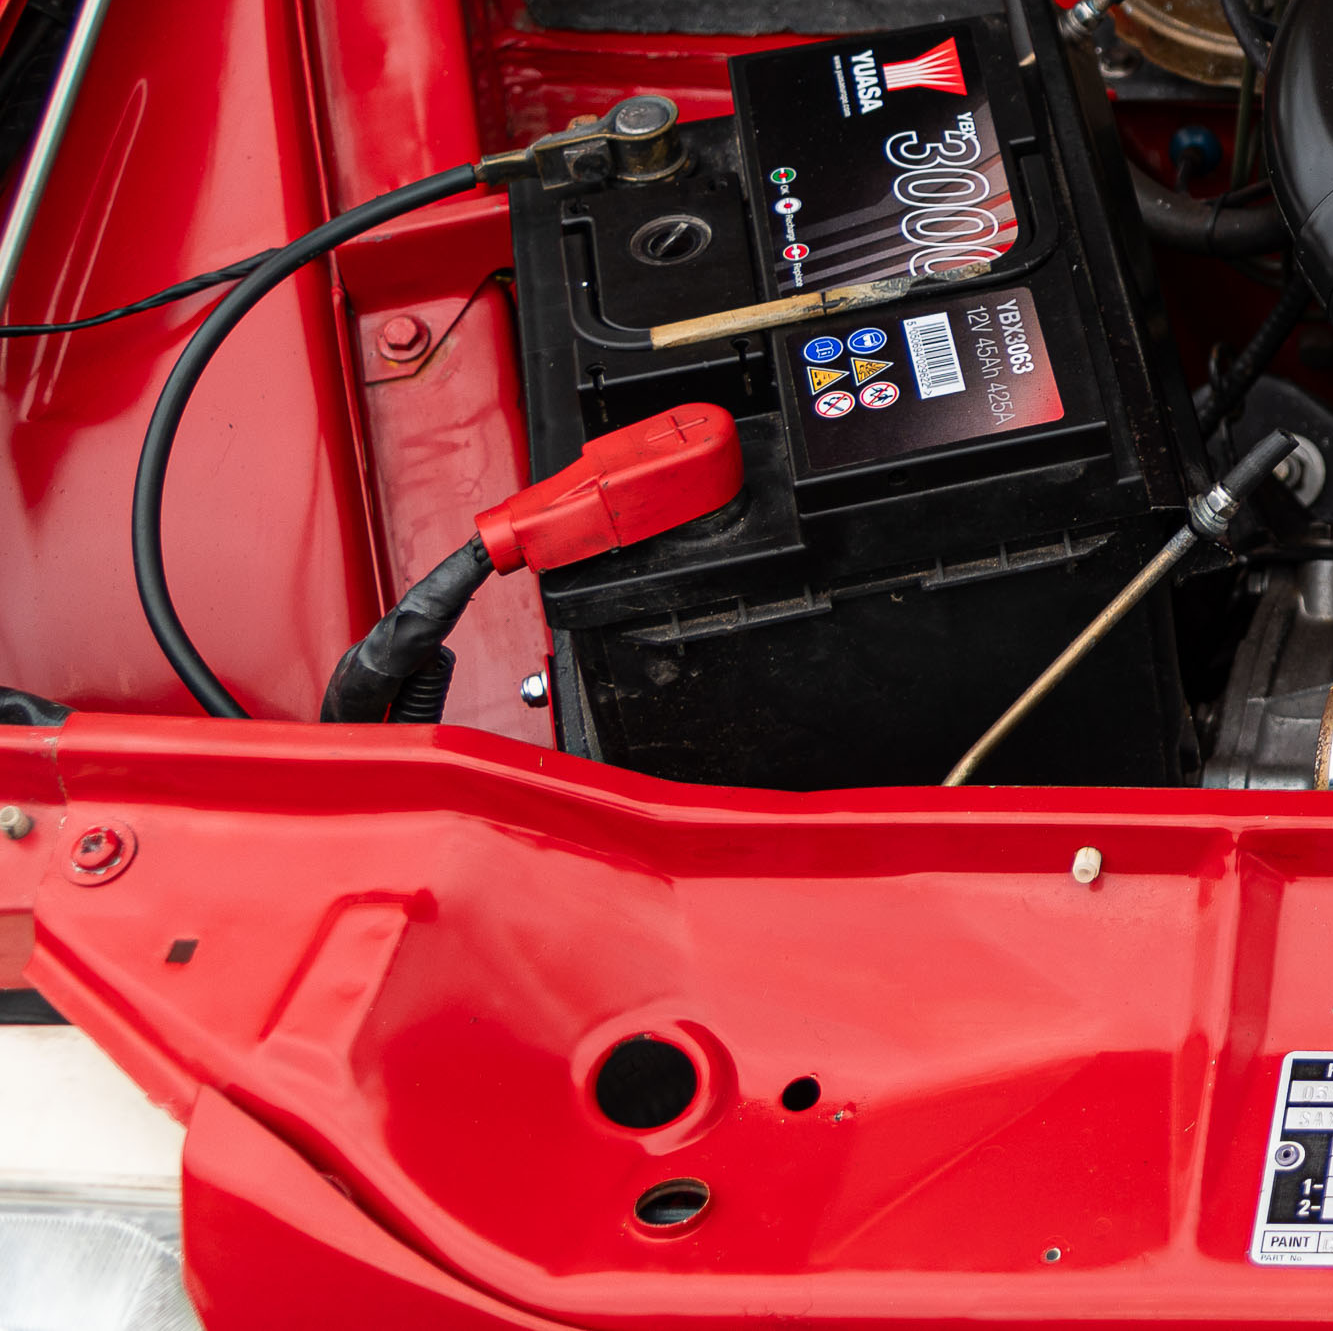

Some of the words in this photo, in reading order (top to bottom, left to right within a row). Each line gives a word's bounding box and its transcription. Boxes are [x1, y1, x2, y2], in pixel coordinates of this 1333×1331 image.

[851, 49, 884, 114] YUASA
[957, 111, 977, 141] YBX
[780, 184, 790, 196] OK
[785, 214, 796, 242] Recharge
[793, 263, 804, 287] Replace
[966, 305, 991, 339] 12V
[995, 299, 1035, 375] YBX3063
[974, 339, 999, 382] 45Ah
[987, 377, 1016, 426] 425A
[1270, 1235, 1312, 1249] PAINT
[1259, 1254, 1286, 1262] PART
